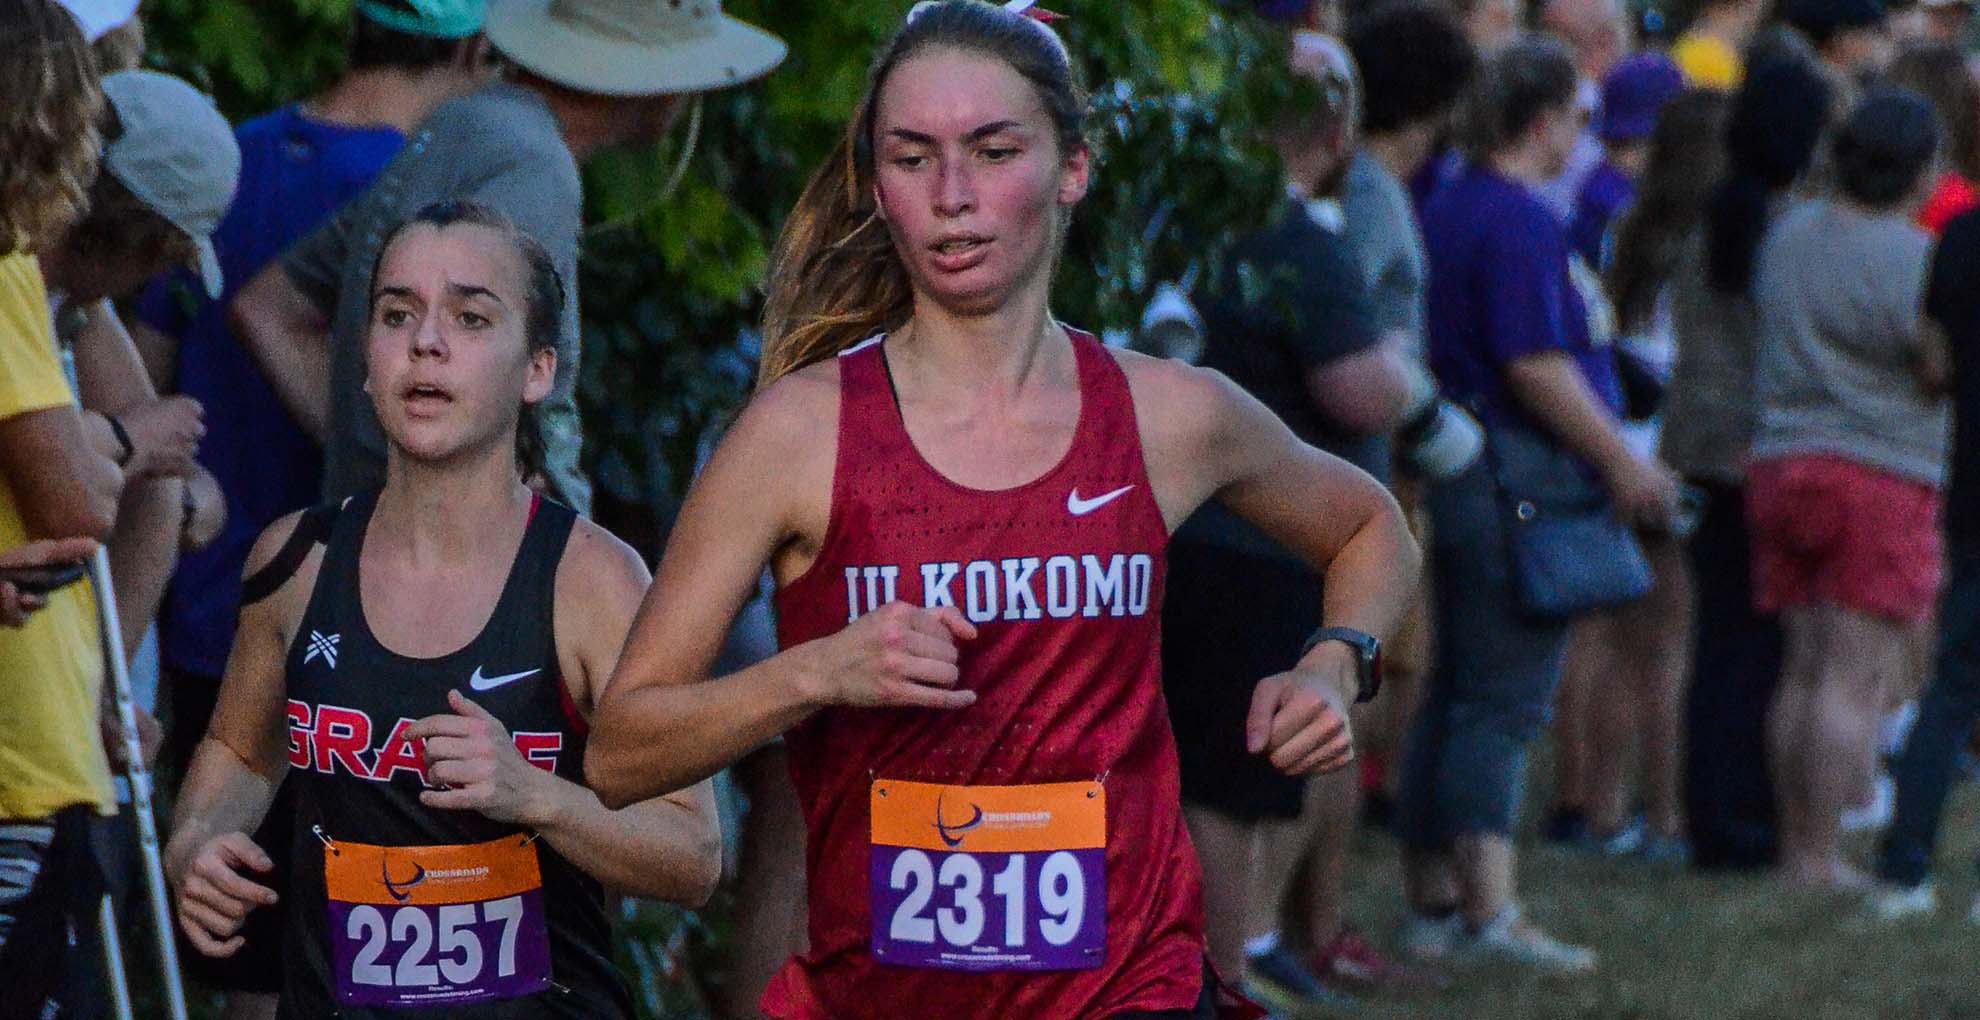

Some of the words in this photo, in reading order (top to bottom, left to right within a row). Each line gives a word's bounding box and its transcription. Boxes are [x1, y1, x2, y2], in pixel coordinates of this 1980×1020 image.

[920, 554, 1153, 623] KOKOMO
[287, 698, 562, 789] GRAE
[347, 895, 524, 986] 2257
[890, 849, 1086, 947] 2319
